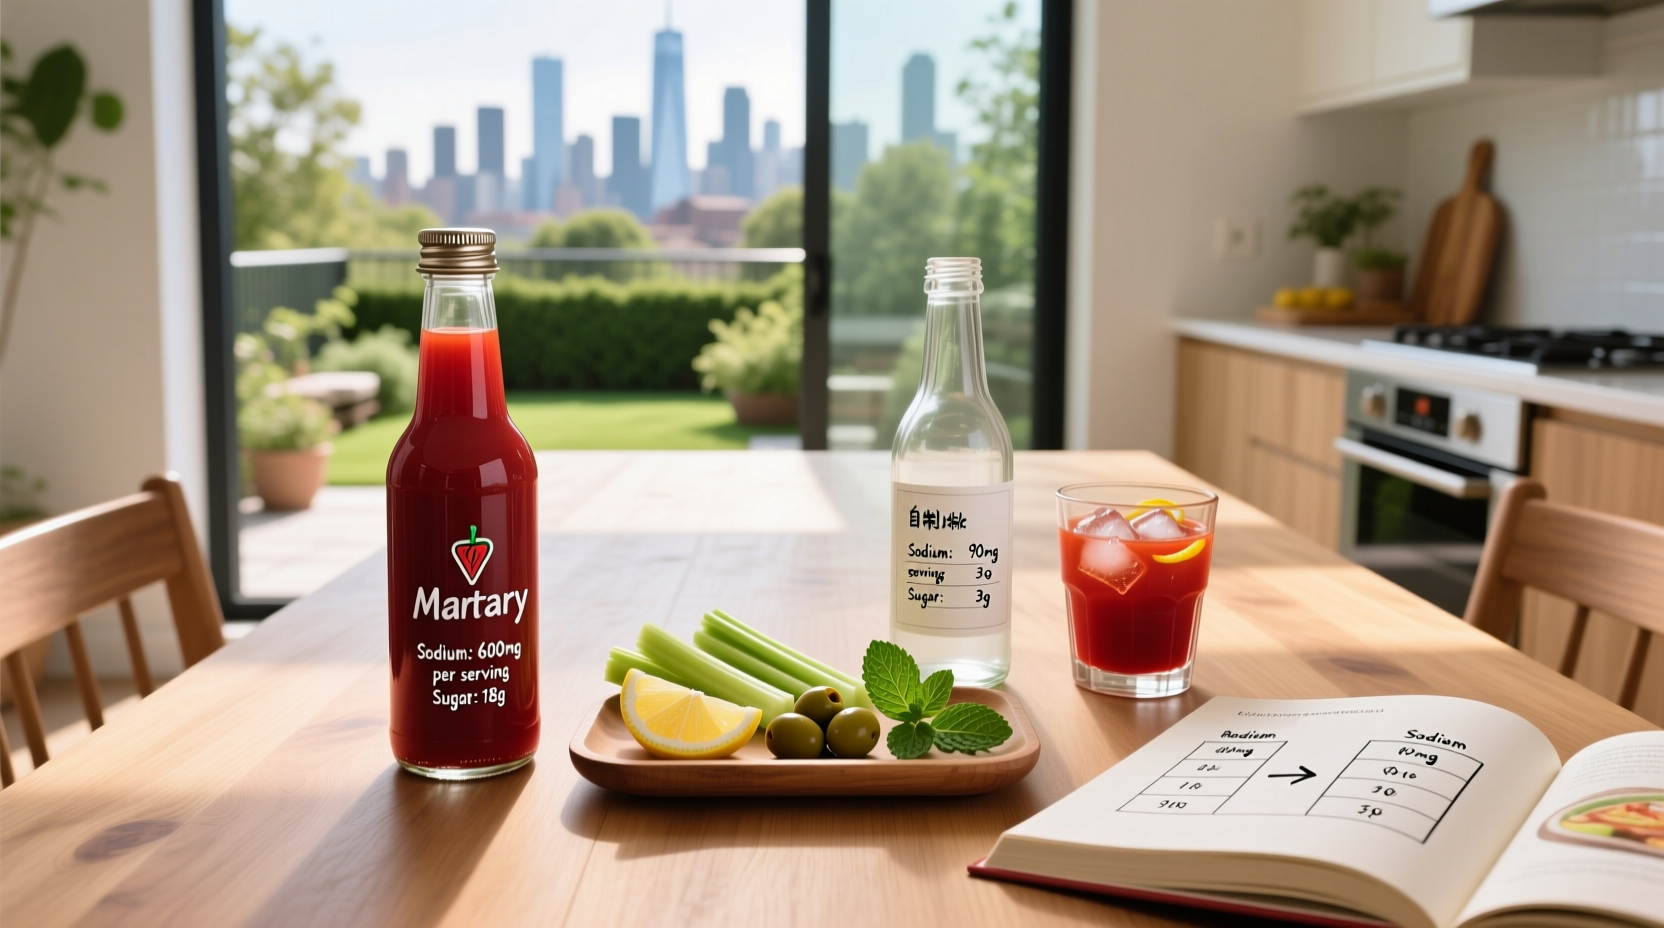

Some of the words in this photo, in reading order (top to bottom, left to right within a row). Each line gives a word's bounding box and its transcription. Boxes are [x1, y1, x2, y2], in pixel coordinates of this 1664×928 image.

[412, 586, 529, 625] Martary
[907, 587, 944, 609] Sugar:
[975, 589, 991, 609] 3g
[416, 642, 473, 660] Sodium:
[432, 670, 456, 687] per
[460, 665, 510, 682] serving
[432, 689, 479, 711] Sugar:
[481, 687, 506, 707] 18g
